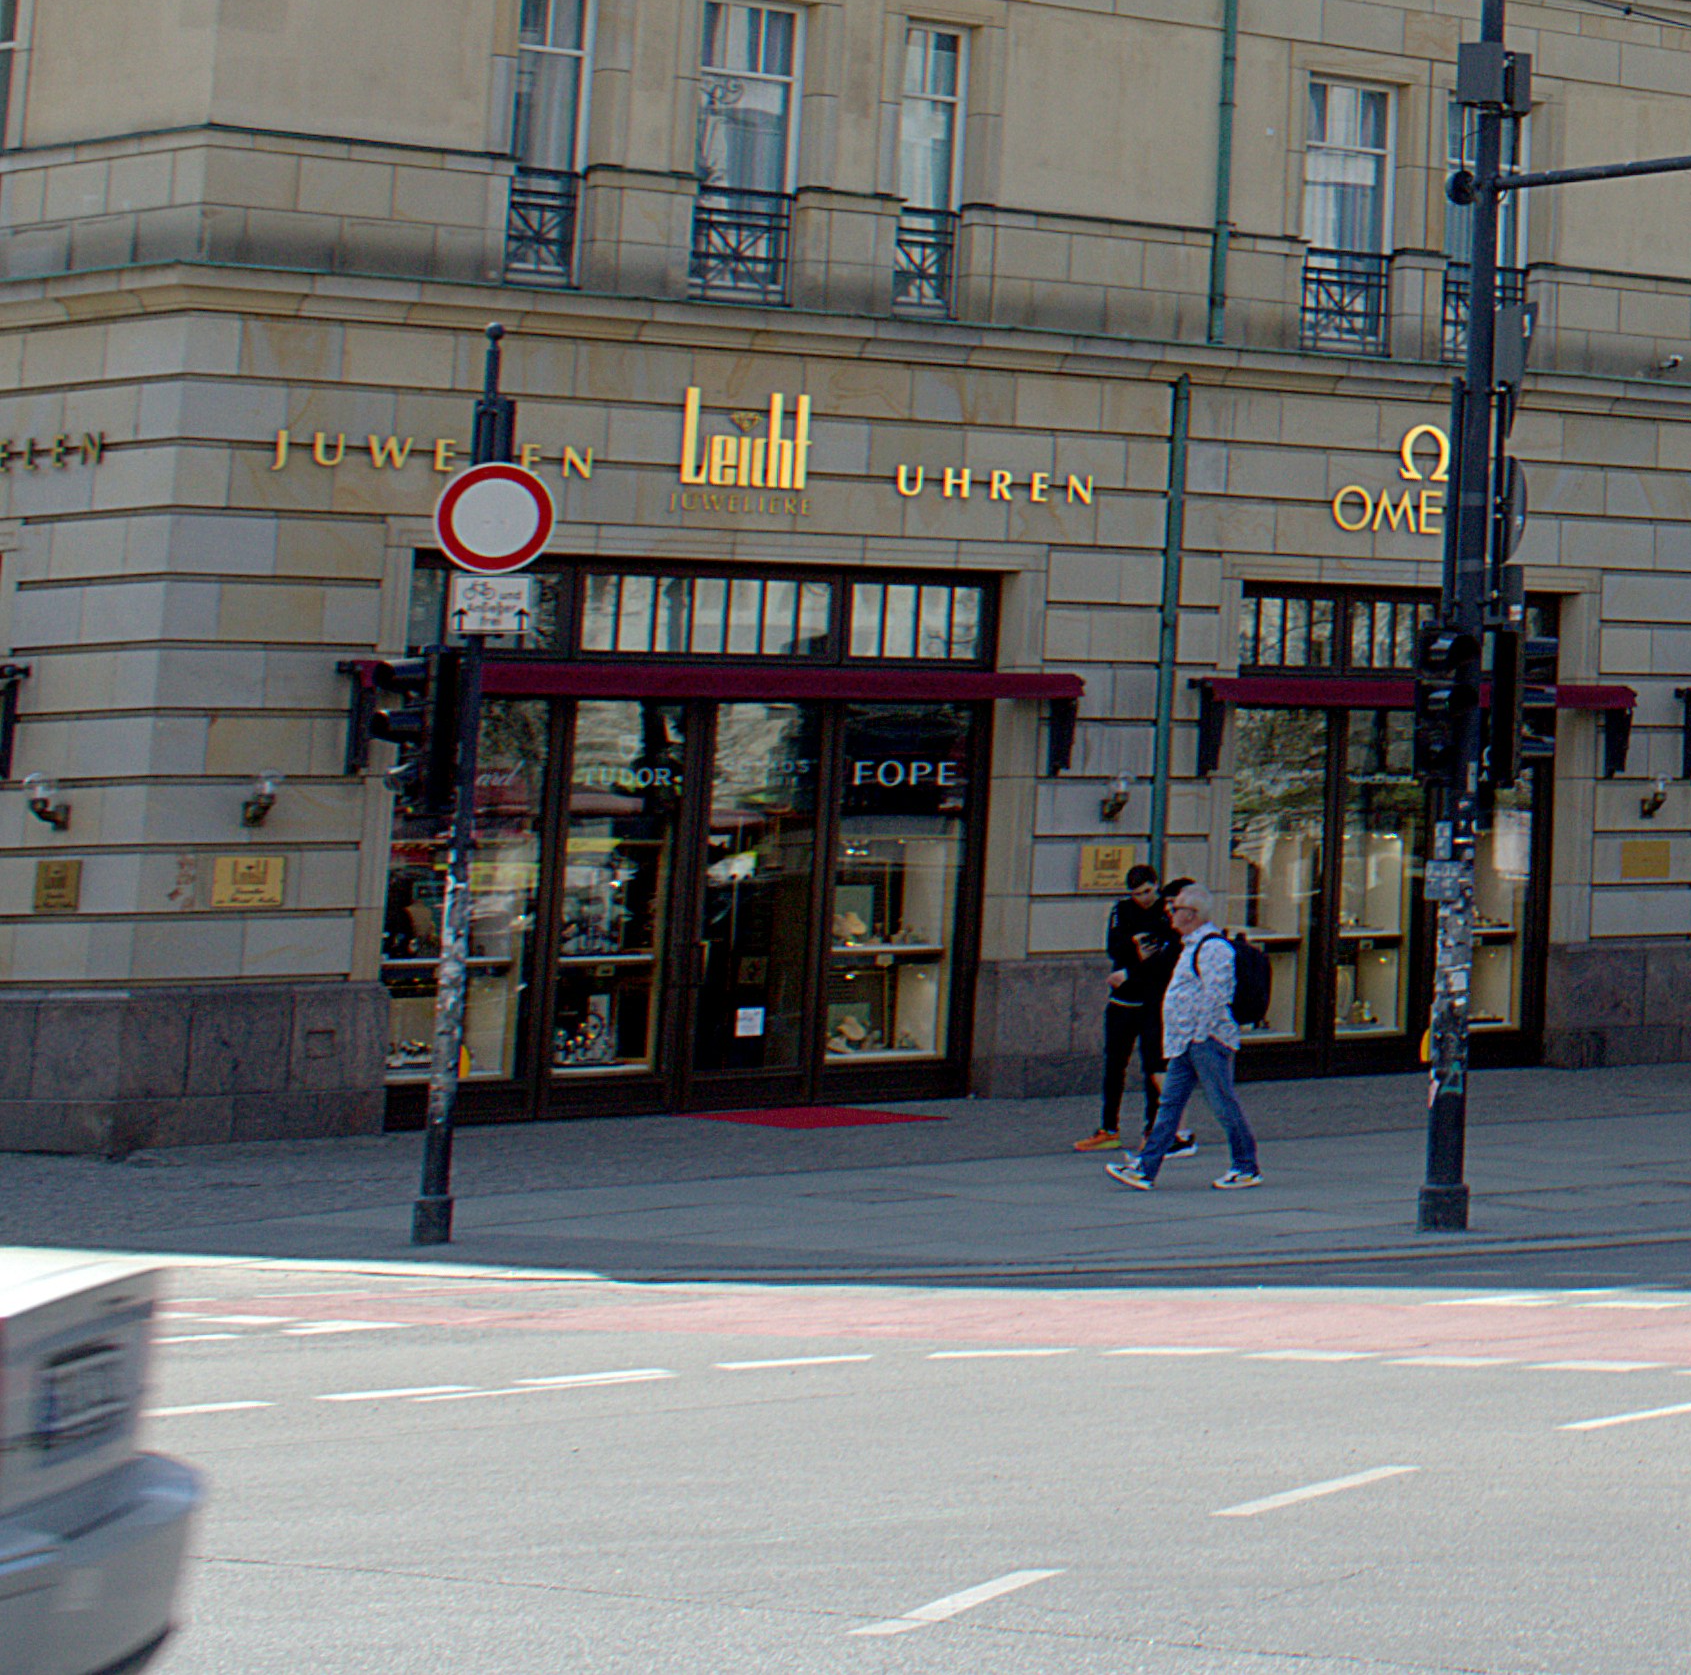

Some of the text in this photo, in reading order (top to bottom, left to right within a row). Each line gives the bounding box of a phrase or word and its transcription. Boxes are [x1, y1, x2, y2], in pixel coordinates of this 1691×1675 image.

[270, 429, 595, 480] JUWEEN
[680, 386, 813, 490] Leicht
[669, 492, 814, 516] JUWELIERE
[896, 463, 1095, 506] UHREN
[1331, 484, 1444, 535] OME
[584, 765, 672, 788] TUDOR
[852, 759, 959, 787] FOPE
